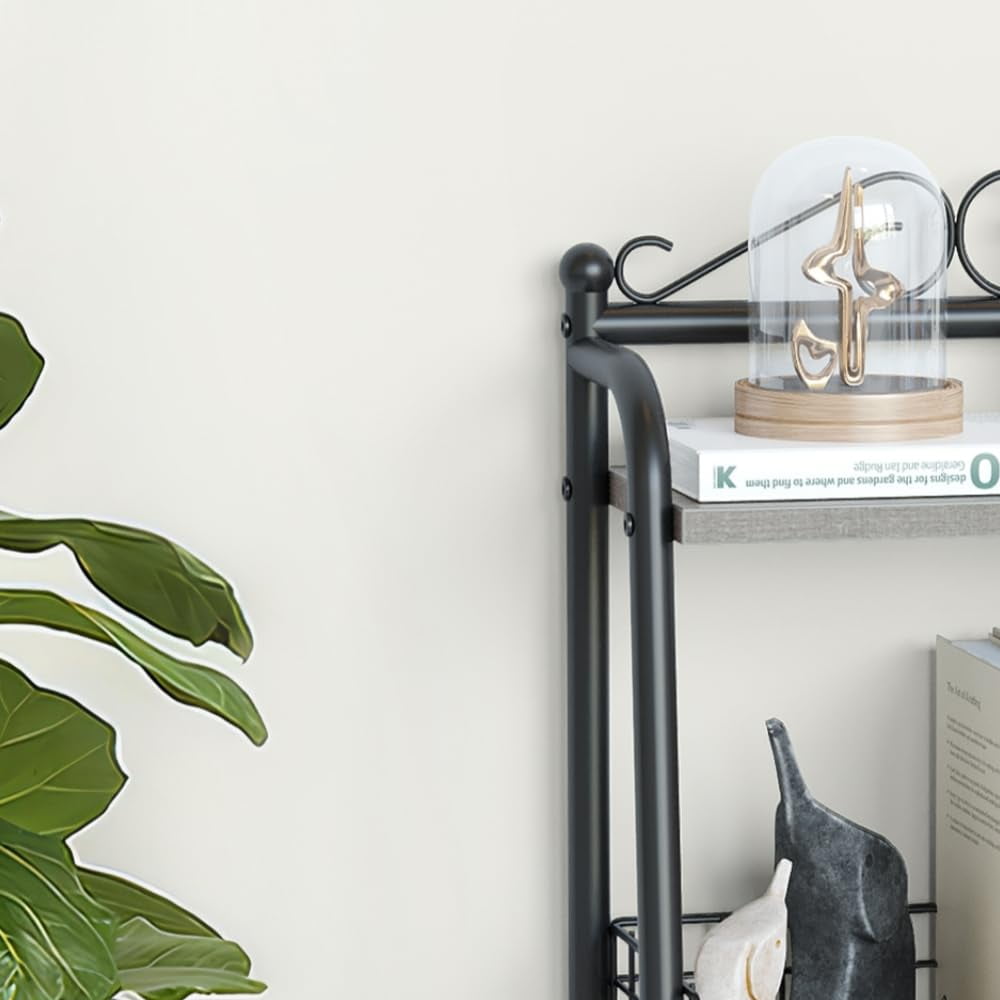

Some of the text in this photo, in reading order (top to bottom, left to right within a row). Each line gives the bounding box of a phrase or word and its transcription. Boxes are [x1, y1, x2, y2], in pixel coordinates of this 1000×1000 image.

[902, 461, 919, 472] and
[745, 472, 967, 489] designs for the gardens and where to find them
